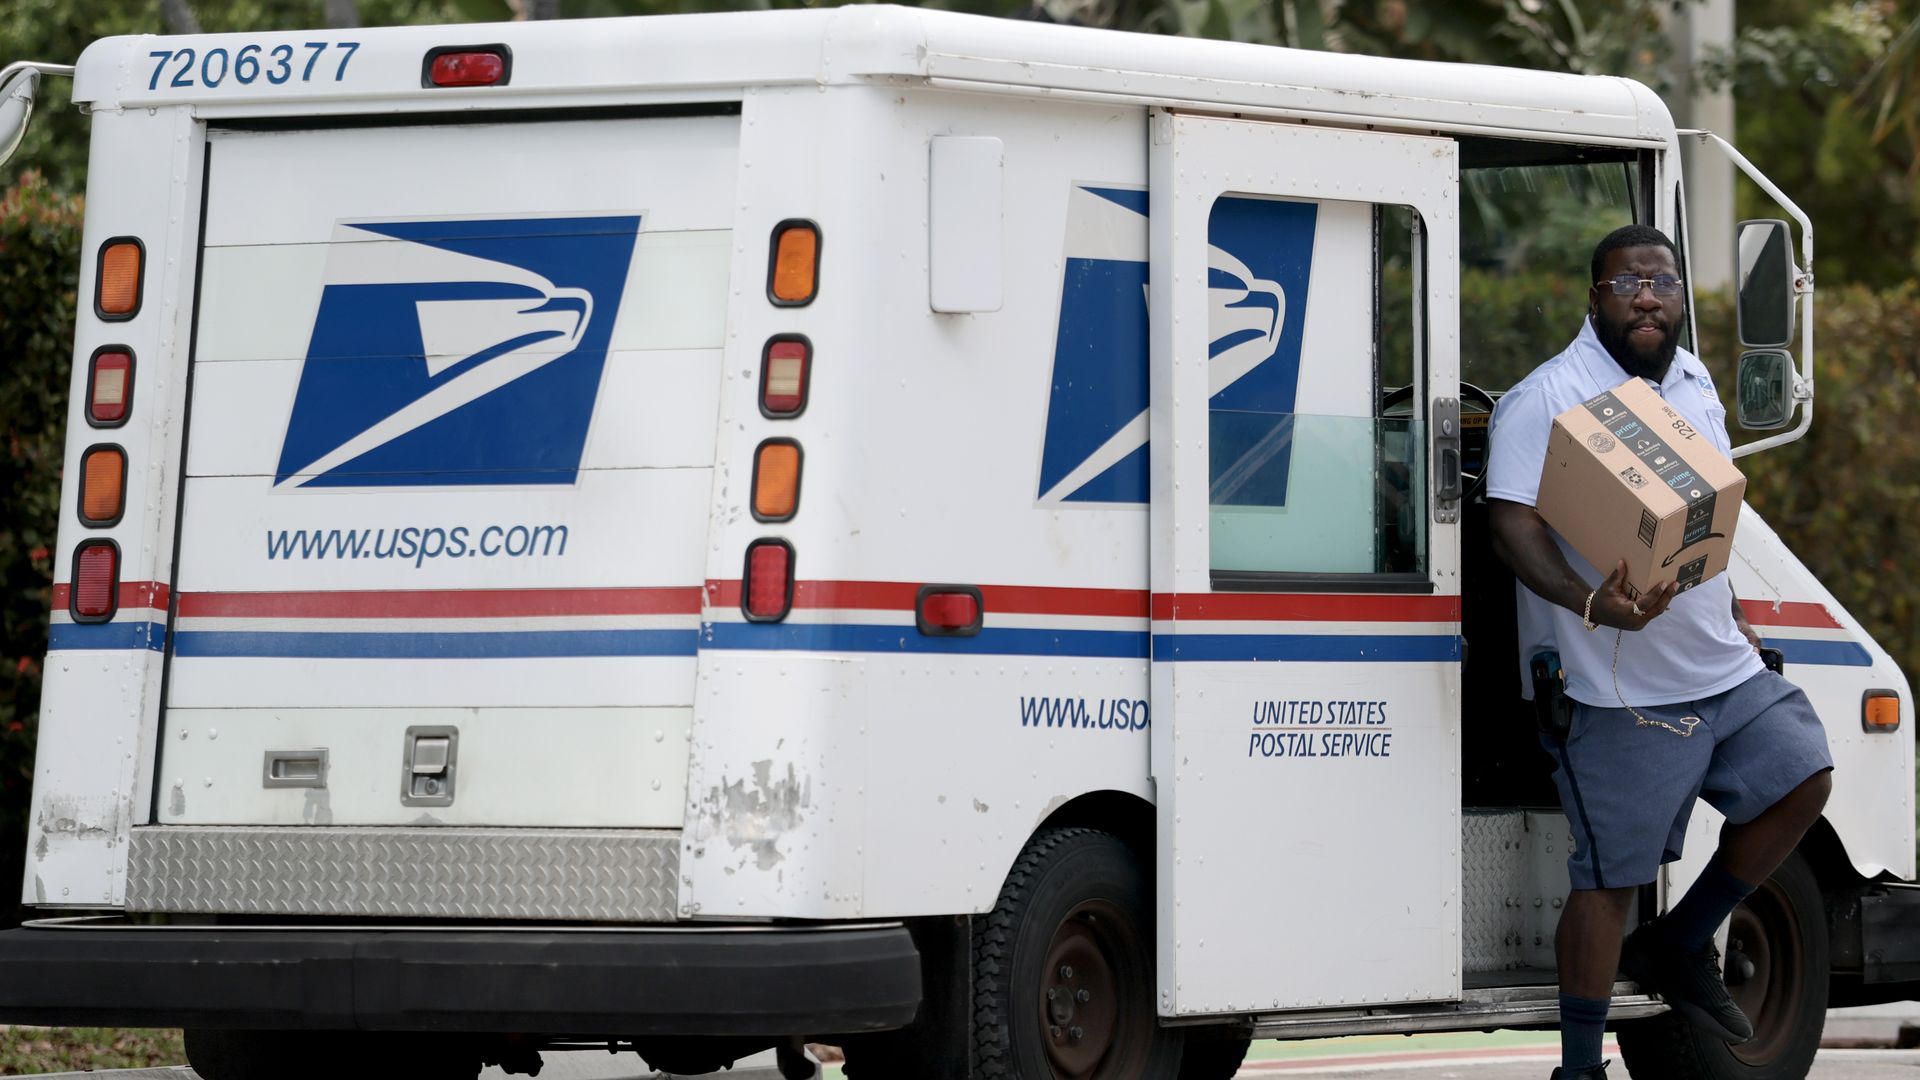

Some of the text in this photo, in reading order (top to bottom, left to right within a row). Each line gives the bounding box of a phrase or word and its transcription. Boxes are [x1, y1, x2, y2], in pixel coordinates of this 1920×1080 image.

[149, 42, 360, 91] 7206377
[1615, 421, 1638, 438] prime
[1672, 420, 1696, 440] 128
[1667, 471, 1691, 487] prime
[1684, 525, 1707, 541] prime
[267, 525, 568, 567] www.usps.com
[1020, 696, 1151, 733] www.usp
[1252, 701, 1387, 725] UNITED STATES
[1248, 733, 1392, 757] POSTAL SERVICE
